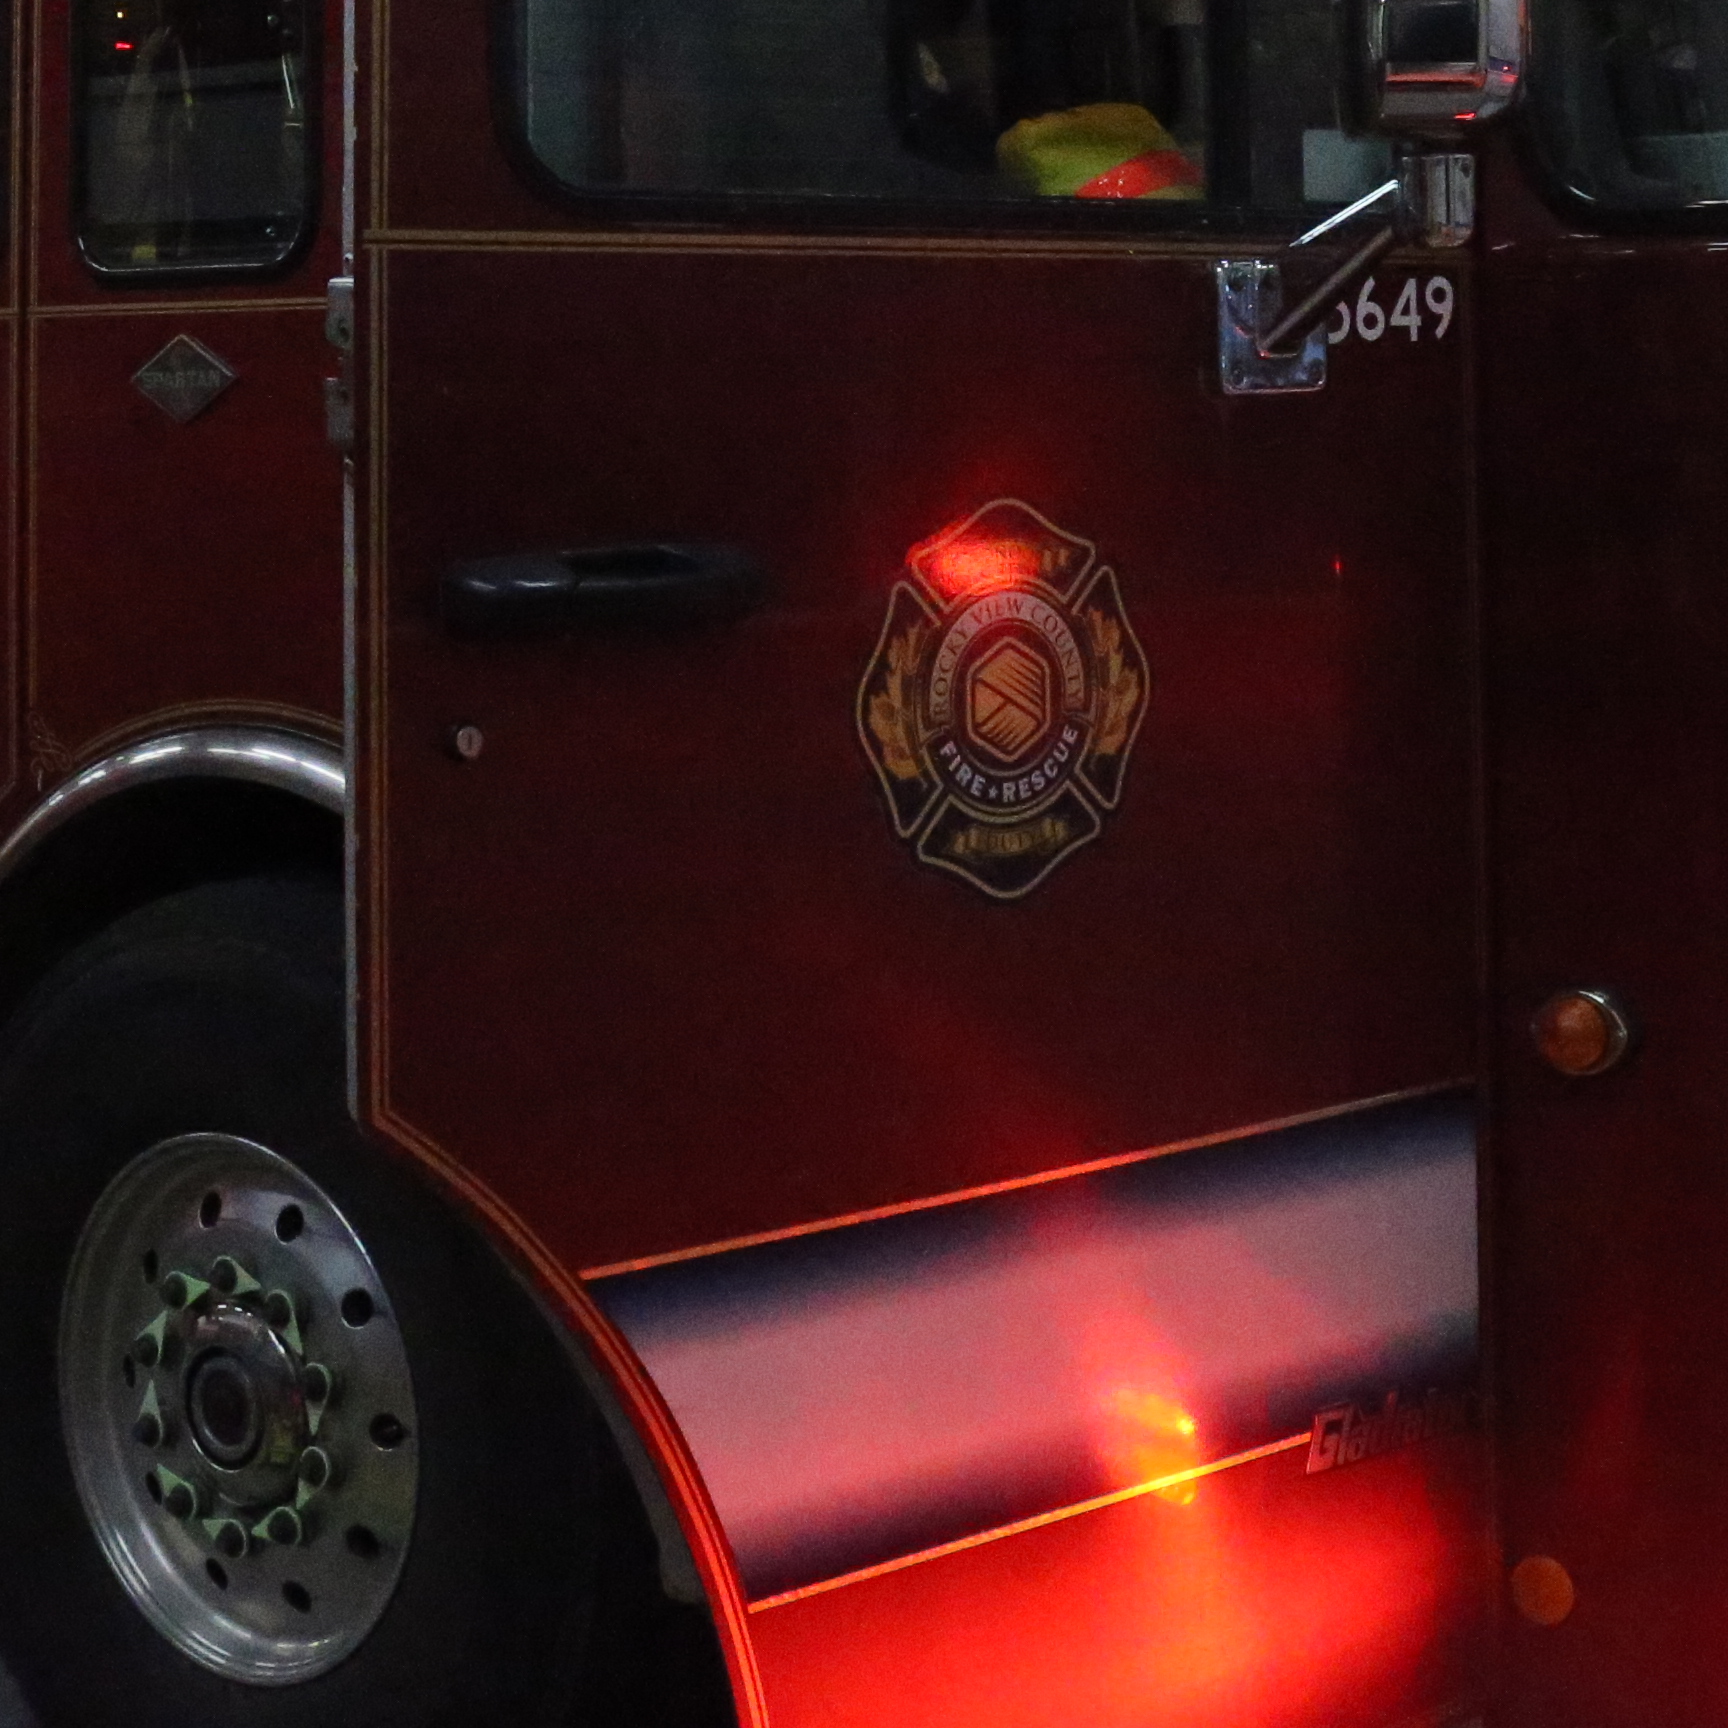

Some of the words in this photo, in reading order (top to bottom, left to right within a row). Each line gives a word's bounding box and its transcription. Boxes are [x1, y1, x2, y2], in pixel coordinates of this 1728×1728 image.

[141, 368, 221, 390] SPARTAN
[933, 630, 970, 716] ROCKY
[973, 596, 1025, 627] VIEW
[1030, 603, 1084, 705] COUNTY
[939, 740, 986, 798] FIRE
[1002, 724, 1079, 803] RESCUE
